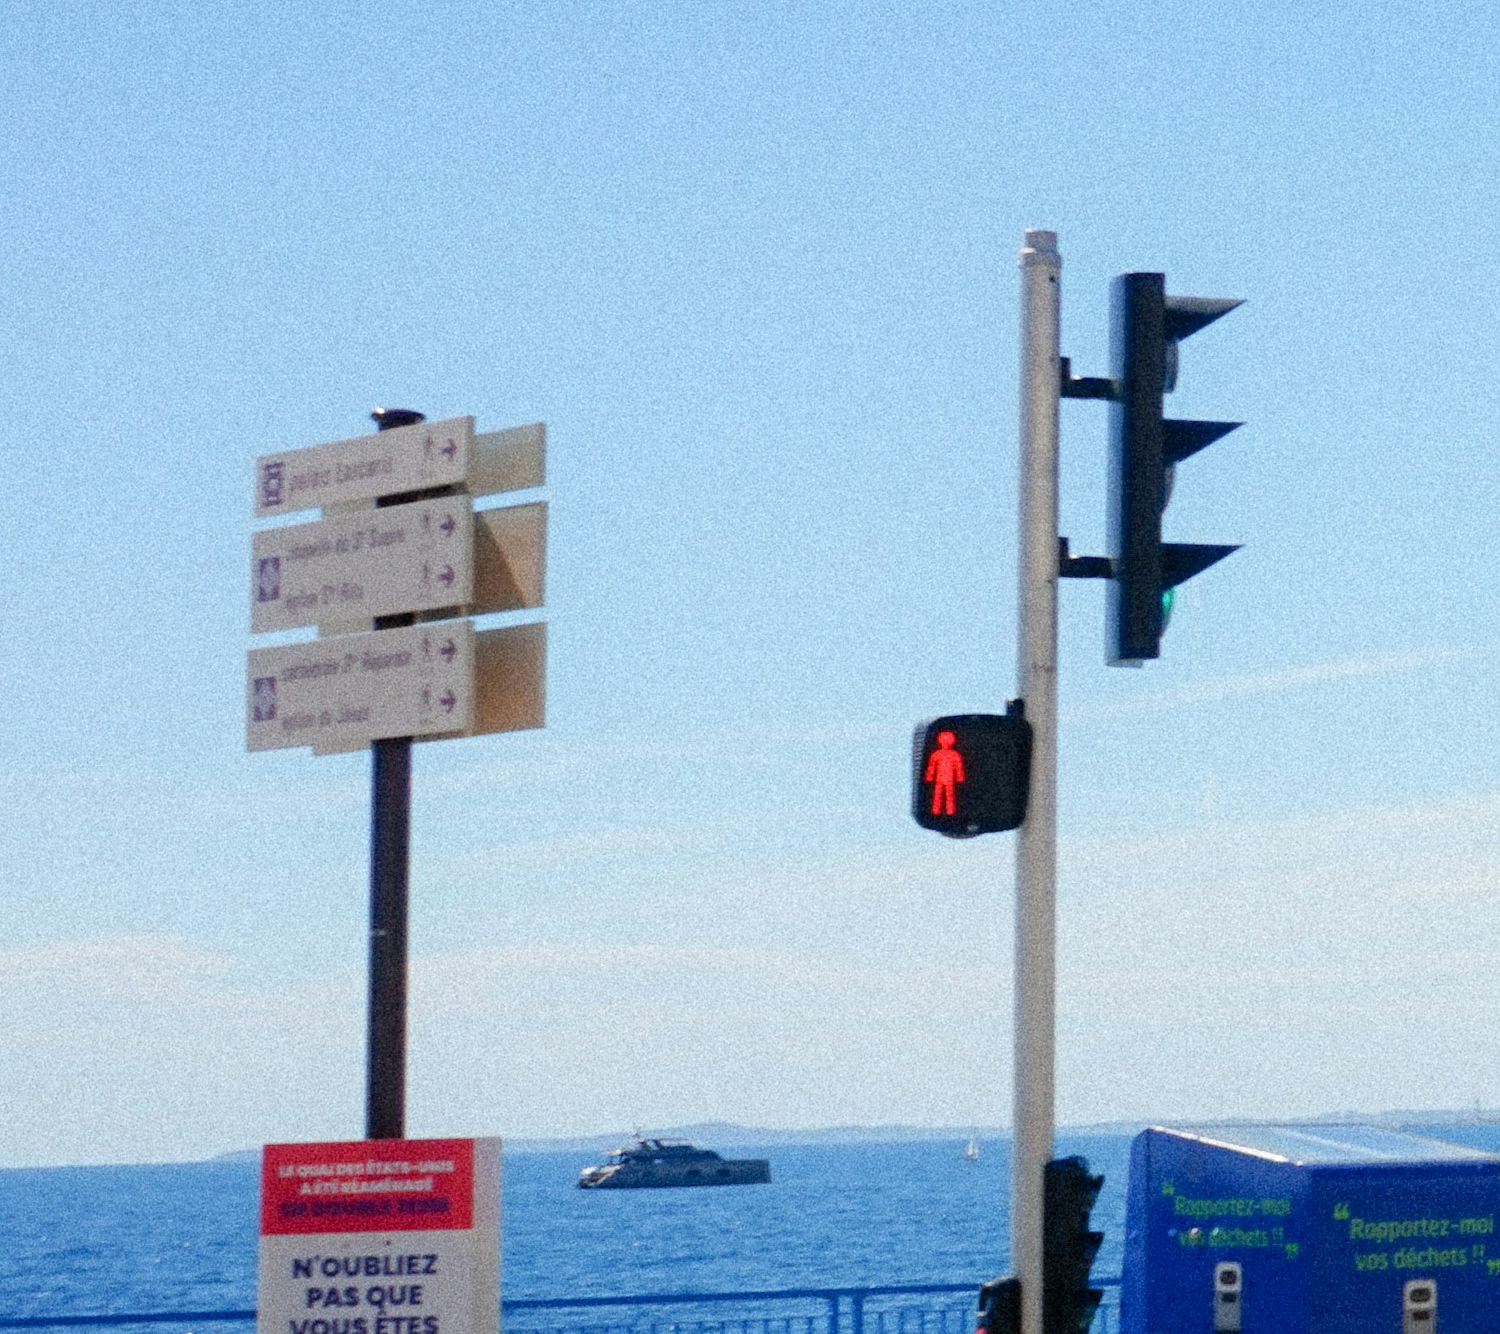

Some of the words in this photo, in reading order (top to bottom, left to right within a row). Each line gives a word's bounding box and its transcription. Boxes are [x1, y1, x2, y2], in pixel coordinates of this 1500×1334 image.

[1351, 1213, 1494, 1243] Rapportez-moi
[291, 1254, 439, 1279] N'OUBLIEZ
[1355, 1252, 1389, 1270] vos
[1393, 1246, 1468, 1269] déchets
[305, 1287, 359, 1309] PAS
[366, 1285, 424, 1309] QUE
